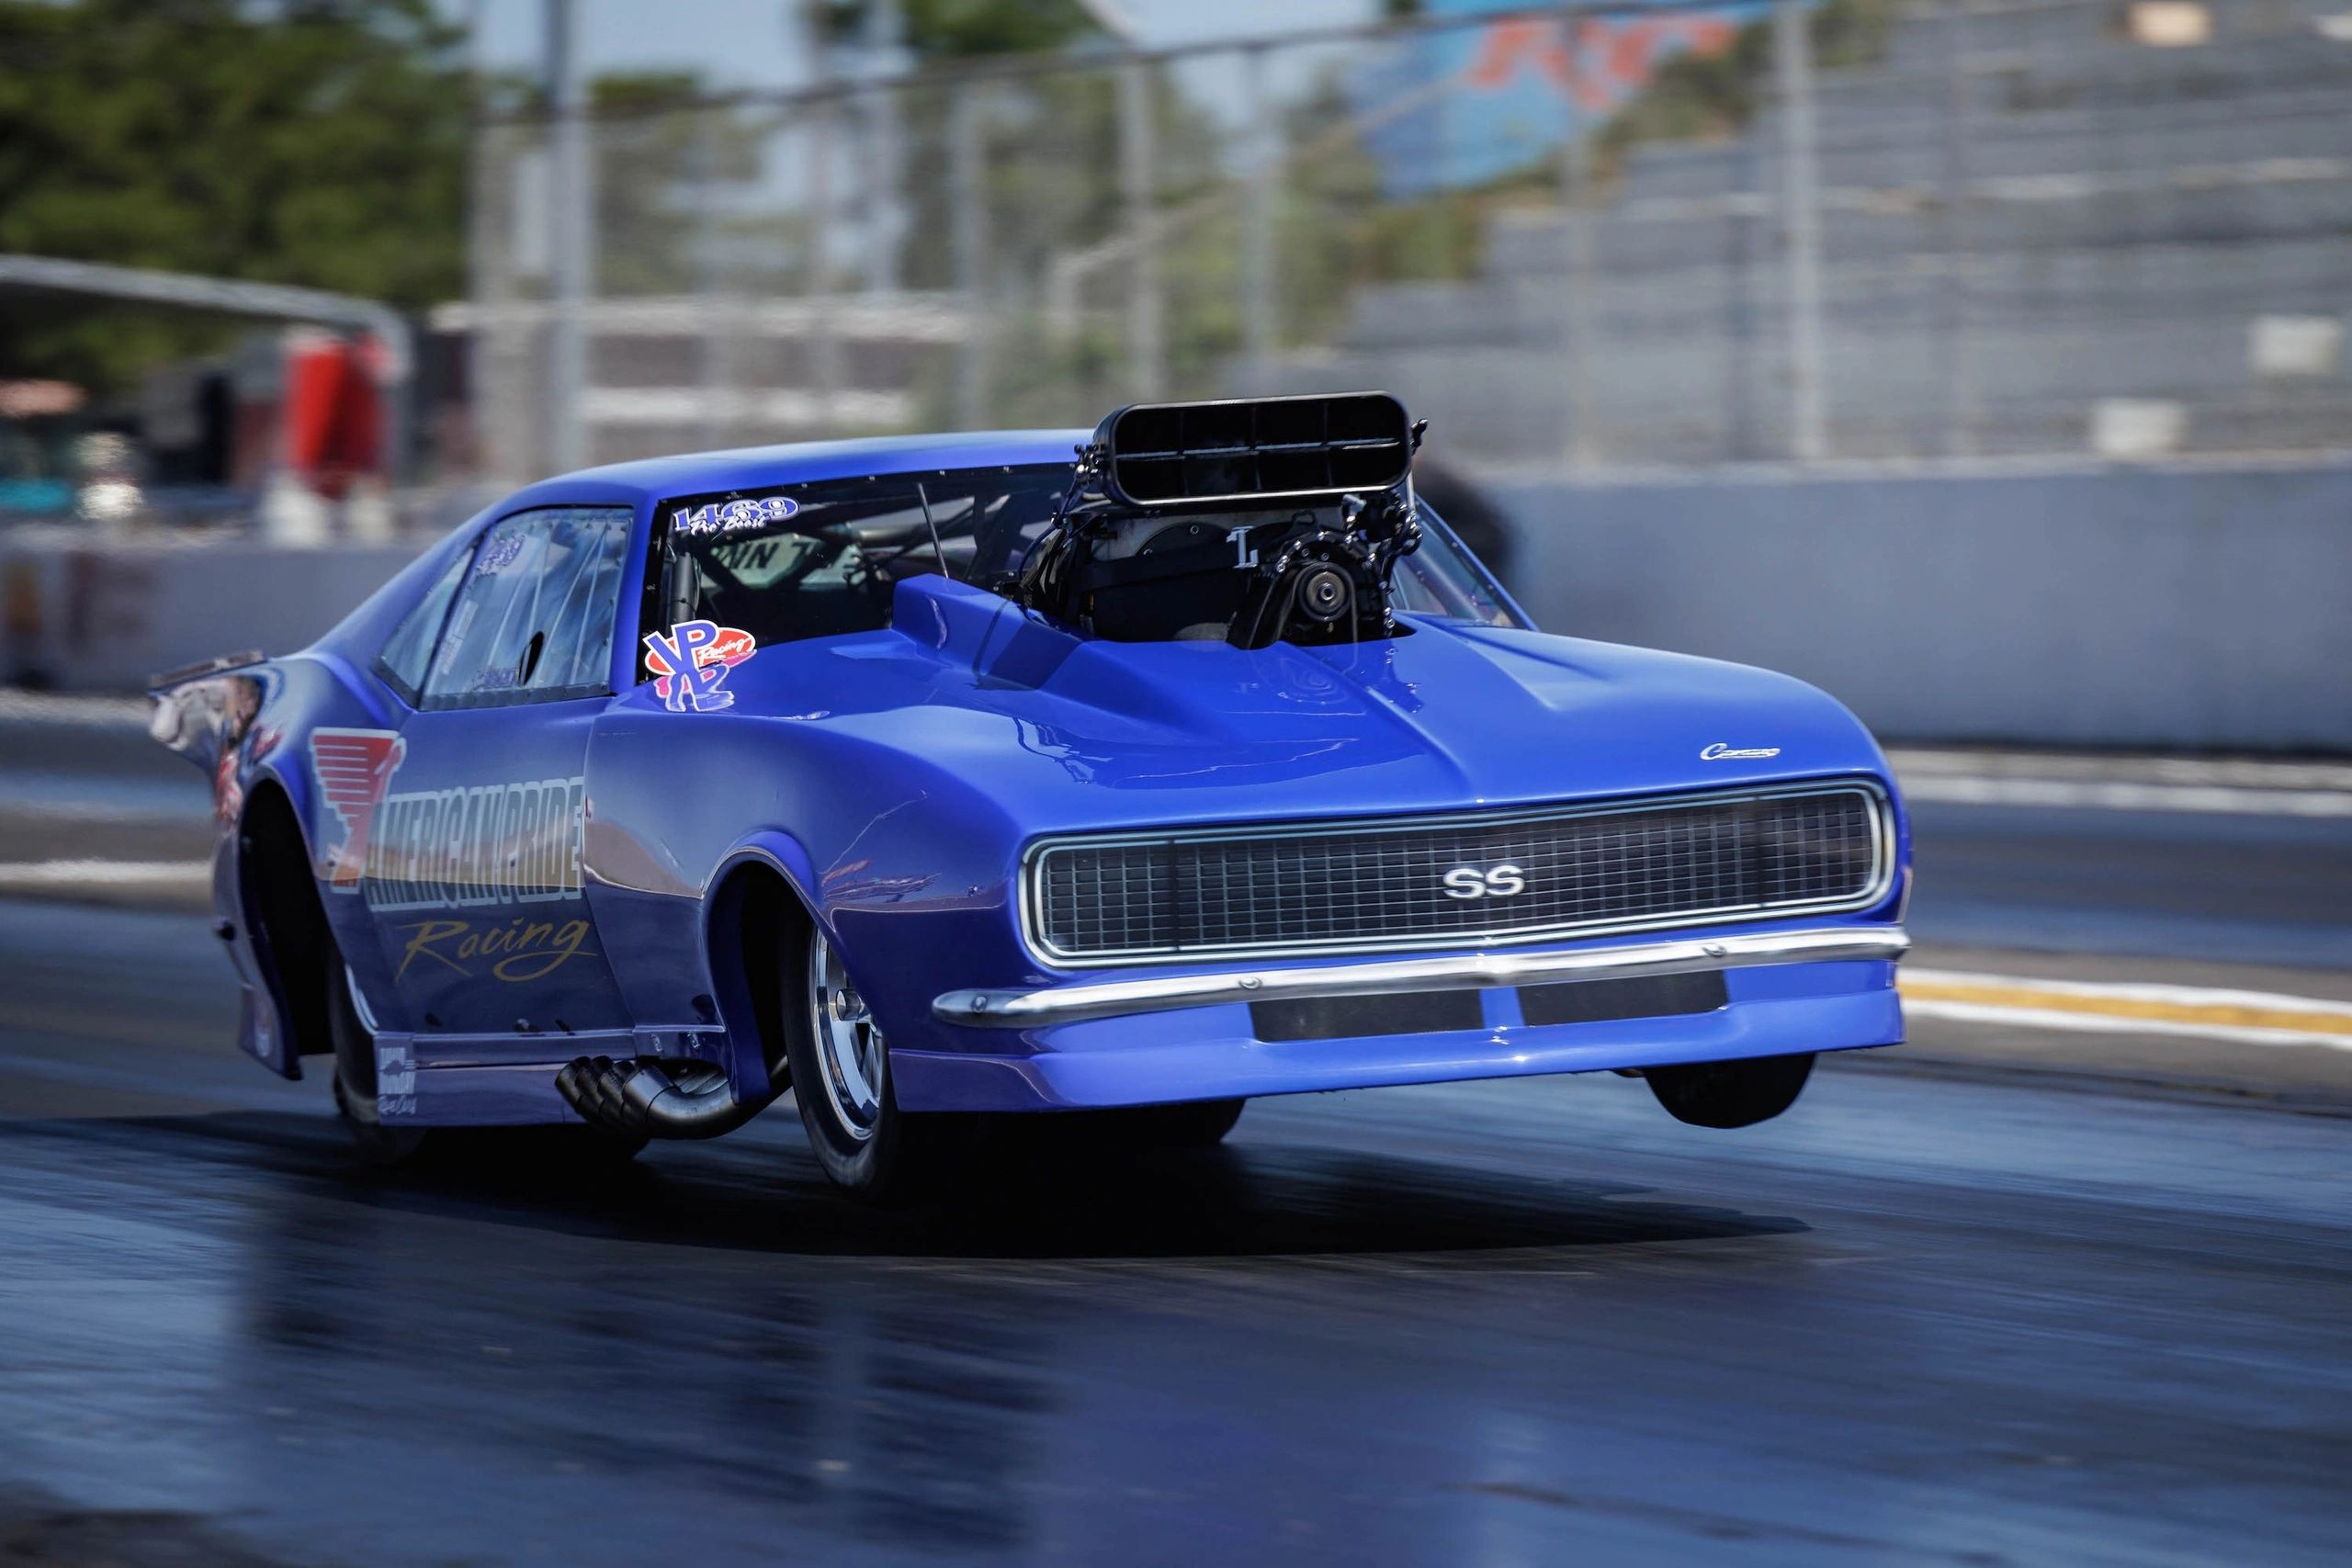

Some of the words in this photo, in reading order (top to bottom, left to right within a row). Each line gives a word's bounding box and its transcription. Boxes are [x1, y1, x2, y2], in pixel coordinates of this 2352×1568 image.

[673, 497, 799, 531] 1469
[642, 619, 720, 675] VP
[697, 637, 753, 667] Racing
[1443, 865, 1525, 899] SS
[394, 918, 597, 985] Racing
